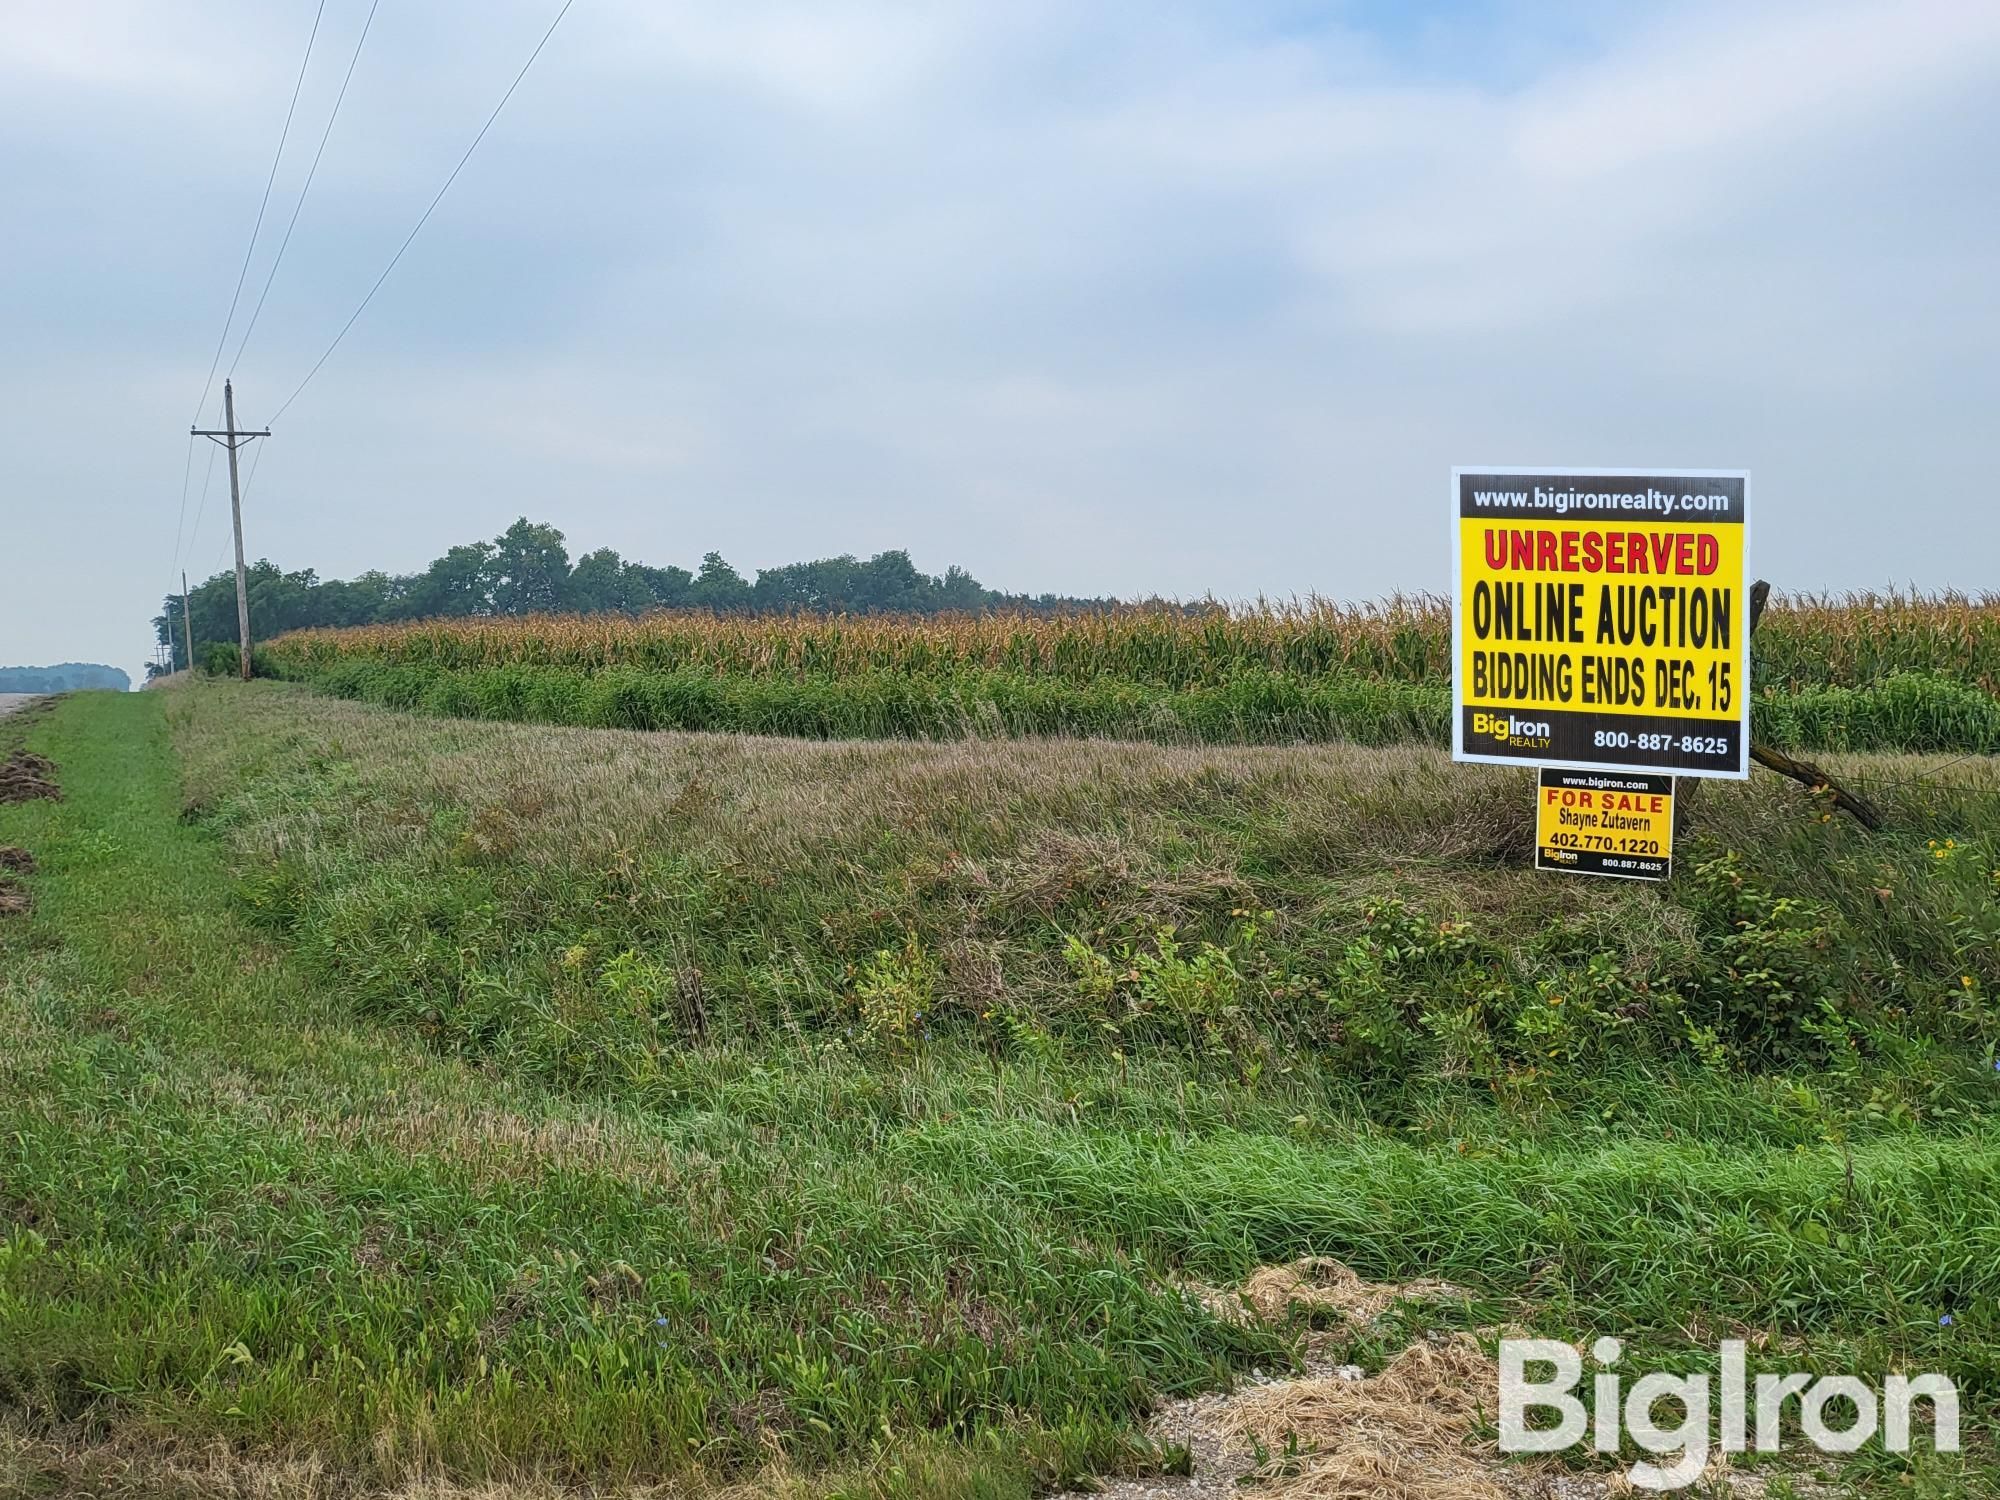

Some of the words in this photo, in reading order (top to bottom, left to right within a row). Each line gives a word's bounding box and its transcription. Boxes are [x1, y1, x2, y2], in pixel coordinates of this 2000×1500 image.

[1474, 487, 1729, 515] www.bigironrealty.com
[1484, 528, 1719, 576] UNRESERVED
[1472, 580, 1585, 644] ONLINE
[1596, 584, 1731, 650] AUCTION
[1472, 650, 1573, 704] BIDDING
[1581, 655, 1646, 707] ENDS
[1655, 659, 1701, 711] DEC.
[1707, 661, 1732, 713] 15
[1473, 713, 1550, 740] BigIron
[1509, 735, 1551, 749] REALTY
[1594, 730, 1728, 755] 800-887-8625
[1562, 776, 1649, 790] www.bigiron.com
[1547, 789, 1593, 809] FOR
[1601, 793, 1663, 814] SALE
[1559, 807, 1598, 831] Shayne
[1601, 810, 1651, 832] Zutavern
[1544, 848, 1578, 861] BigIron
[1550, 832, 1659, 855] 402.770.1220
[1602, 858, 1662, 871] 800.887.8625
